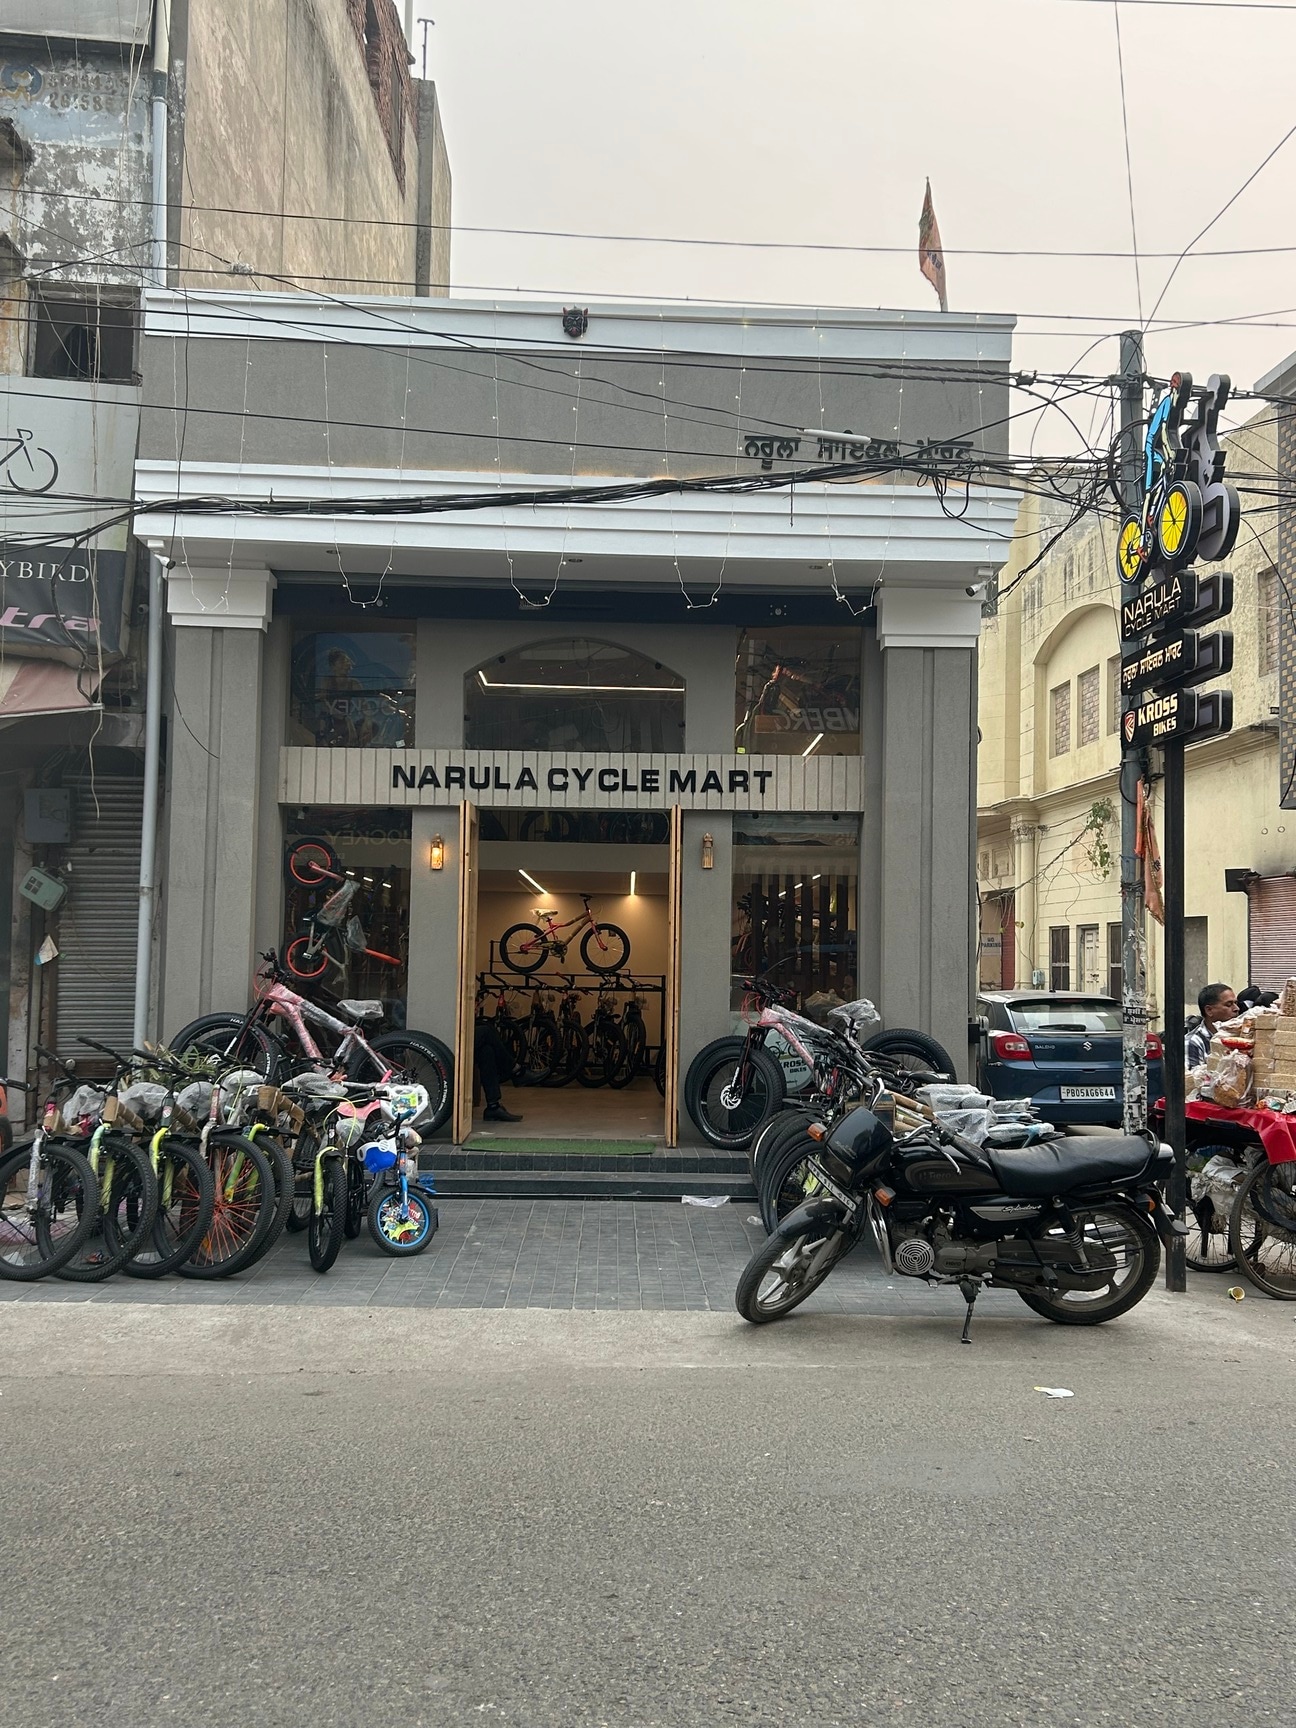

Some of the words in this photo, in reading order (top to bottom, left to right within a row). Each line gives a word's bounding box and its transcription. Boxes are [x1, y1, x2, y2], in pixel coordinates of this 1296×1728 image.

[1124, 577, 1182, 624] NARULA
[1125, 612, 1152, 637] CYCLE
[1154, 595, 1182, 620] MART
[1122, 662, 1139, 689] ਨਰੂਲਾ
[1138, 692, 1178, 727] KROSS
[1153, 716, 1178, 737] BIKES
[392, 765, 538, 791] NARULA
[547, 767, 660, 792] CYCLE
[669, 769, 773, 794] MART
[1066, 1088, 1115, 1098] PB05AG6644
